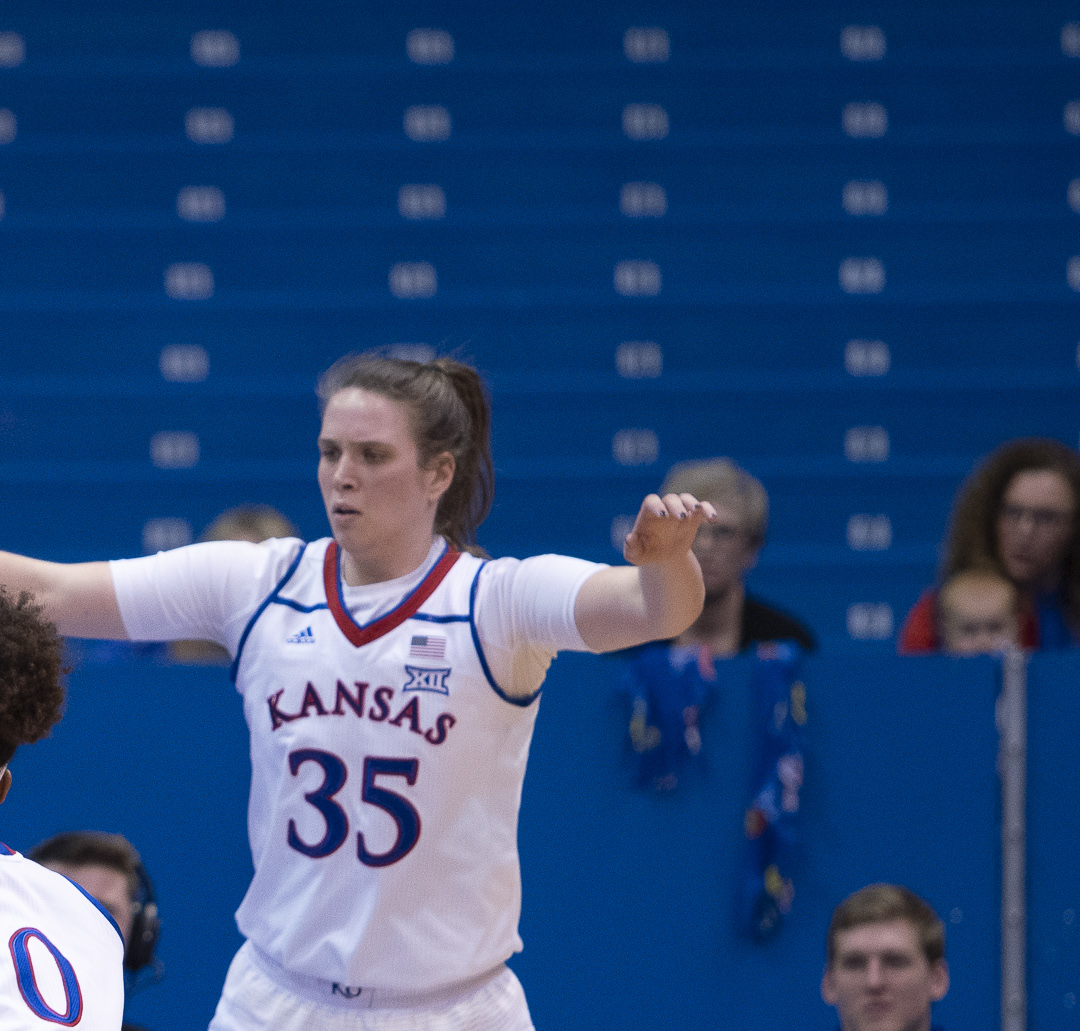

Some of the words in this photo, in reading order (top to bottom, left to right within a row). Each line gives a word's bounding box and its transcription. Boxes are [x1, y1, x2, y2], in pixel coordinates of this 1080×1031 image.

[267, 678, 457, 745] KANSAS
[287, 748, 422, 868] 35
[8, 927, 83, 1027] 0
